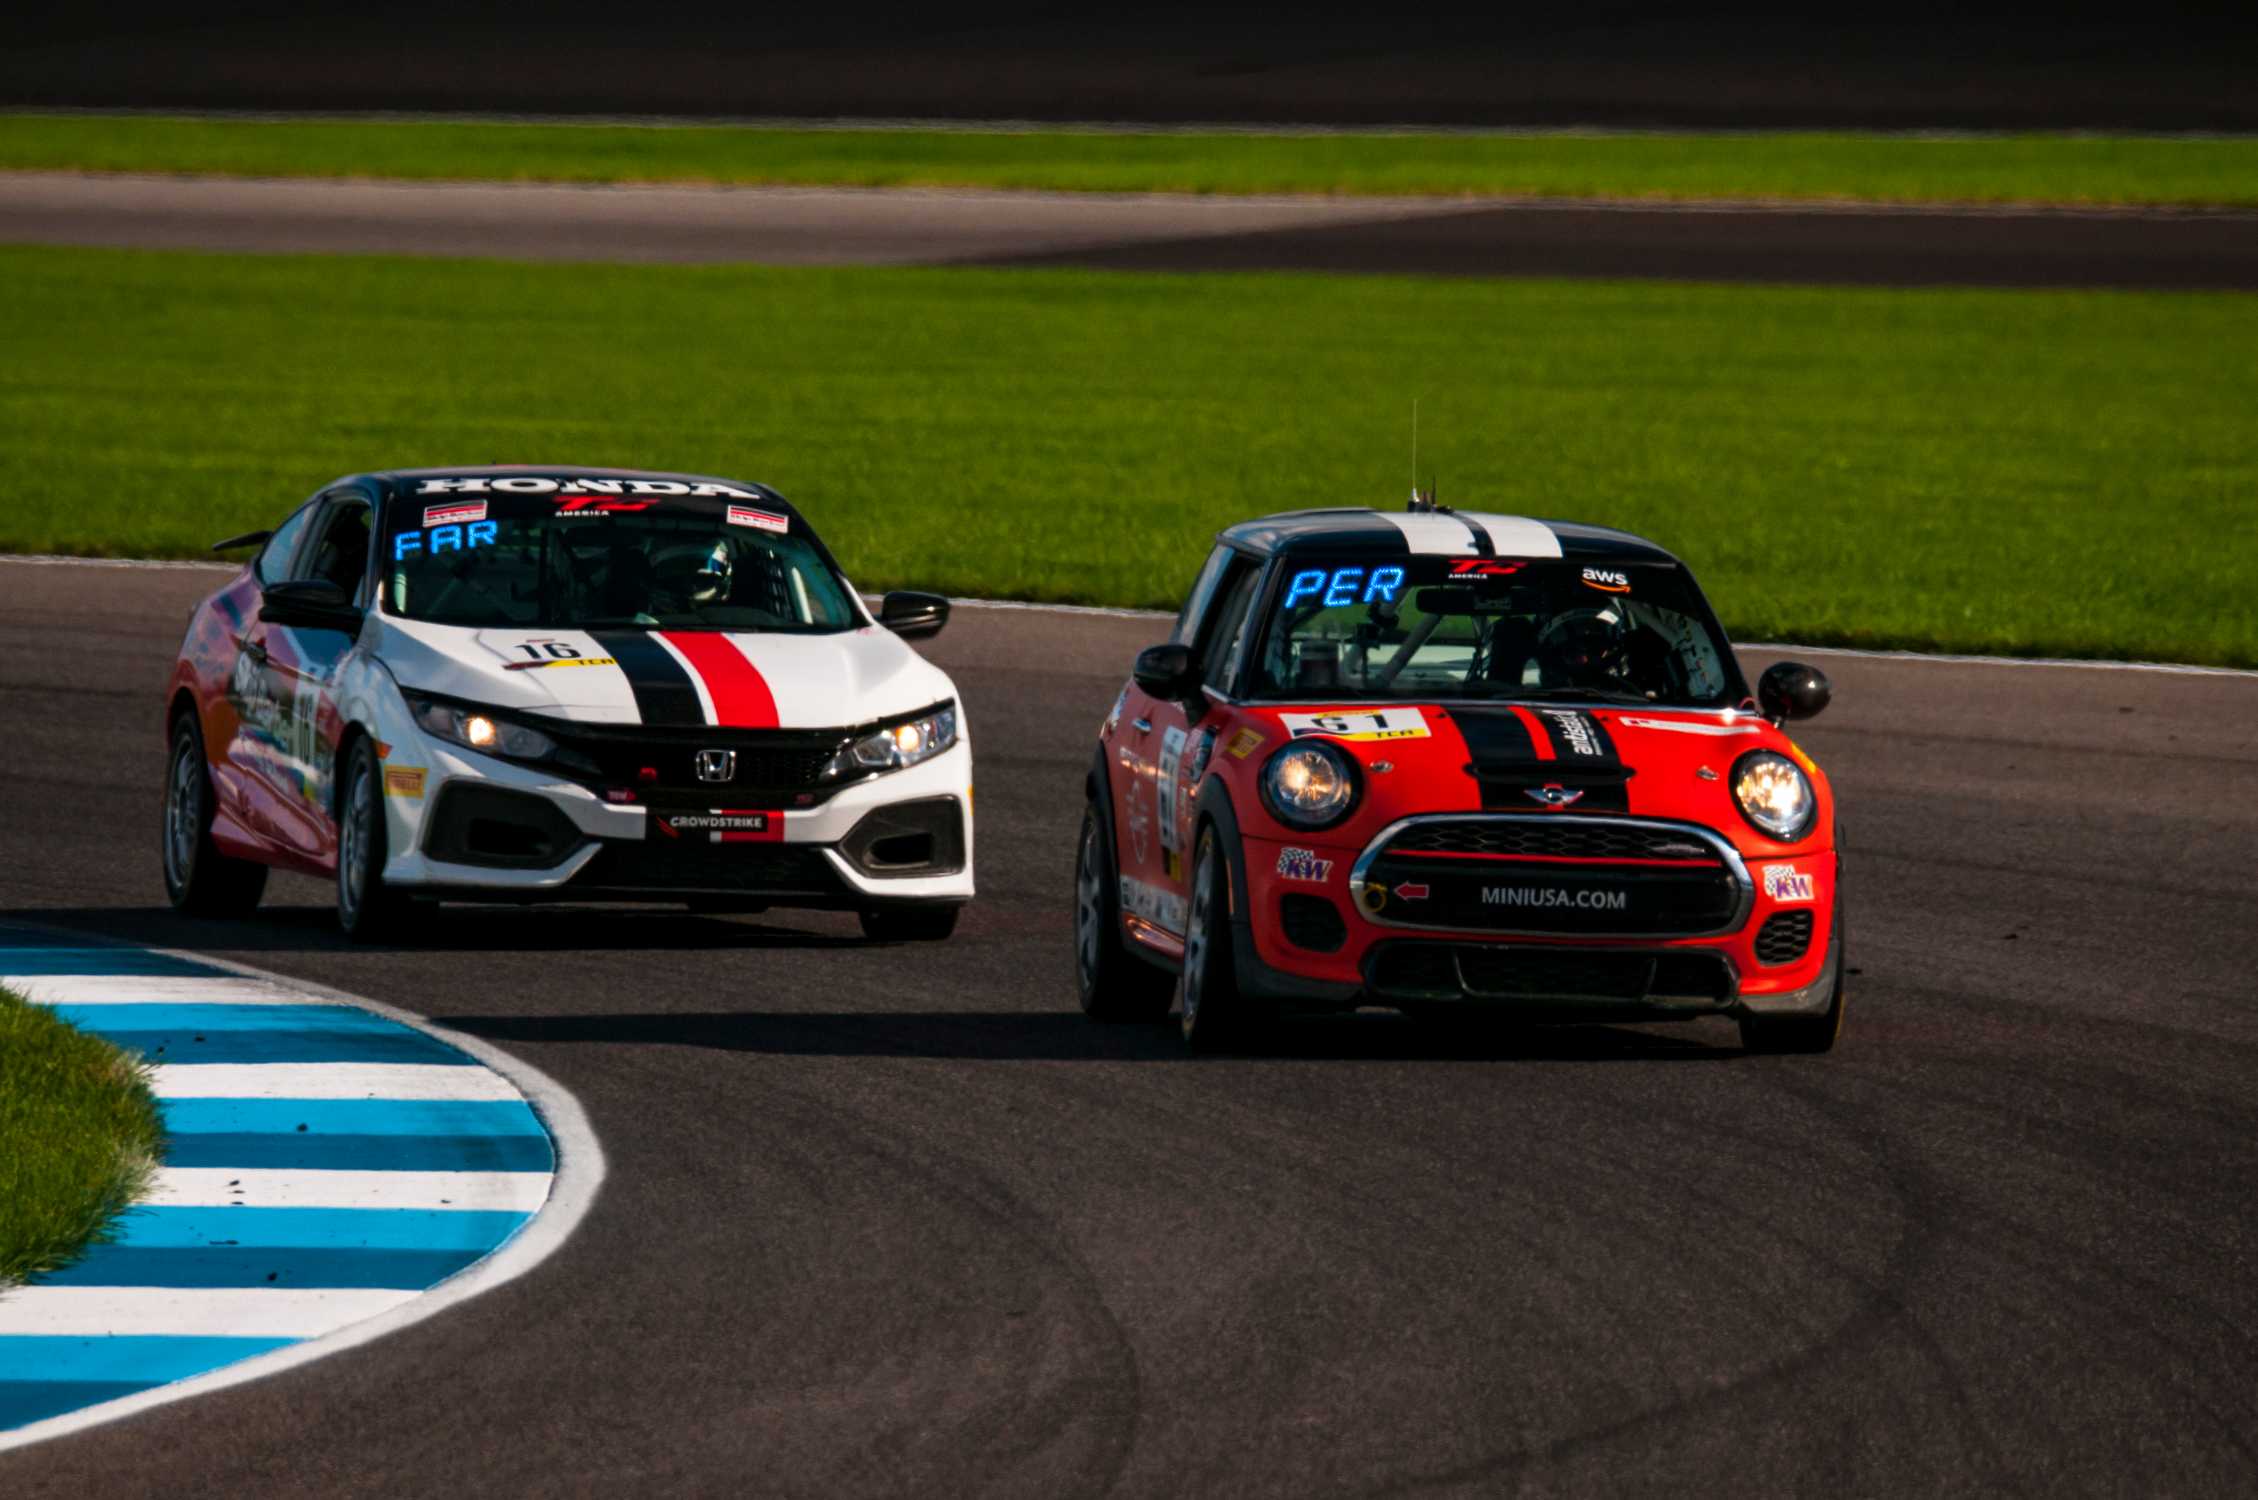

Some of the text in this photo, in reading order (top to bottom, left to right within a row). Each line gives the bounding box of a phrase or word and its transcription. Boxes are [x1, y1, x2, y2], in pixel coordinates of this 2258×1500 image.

[416, 478, 760, 499] HONDA
[395, 520, 497, 560] FAR
[1583, 567, 1628, 585] aws
[1284, 567, 1404, 608] PER
[514, 643, 581, 659] 16
[670, 816, 762, 828] CROWDSTRIKE
[1481, 887, 1626, 909] MINIUSA.COM
